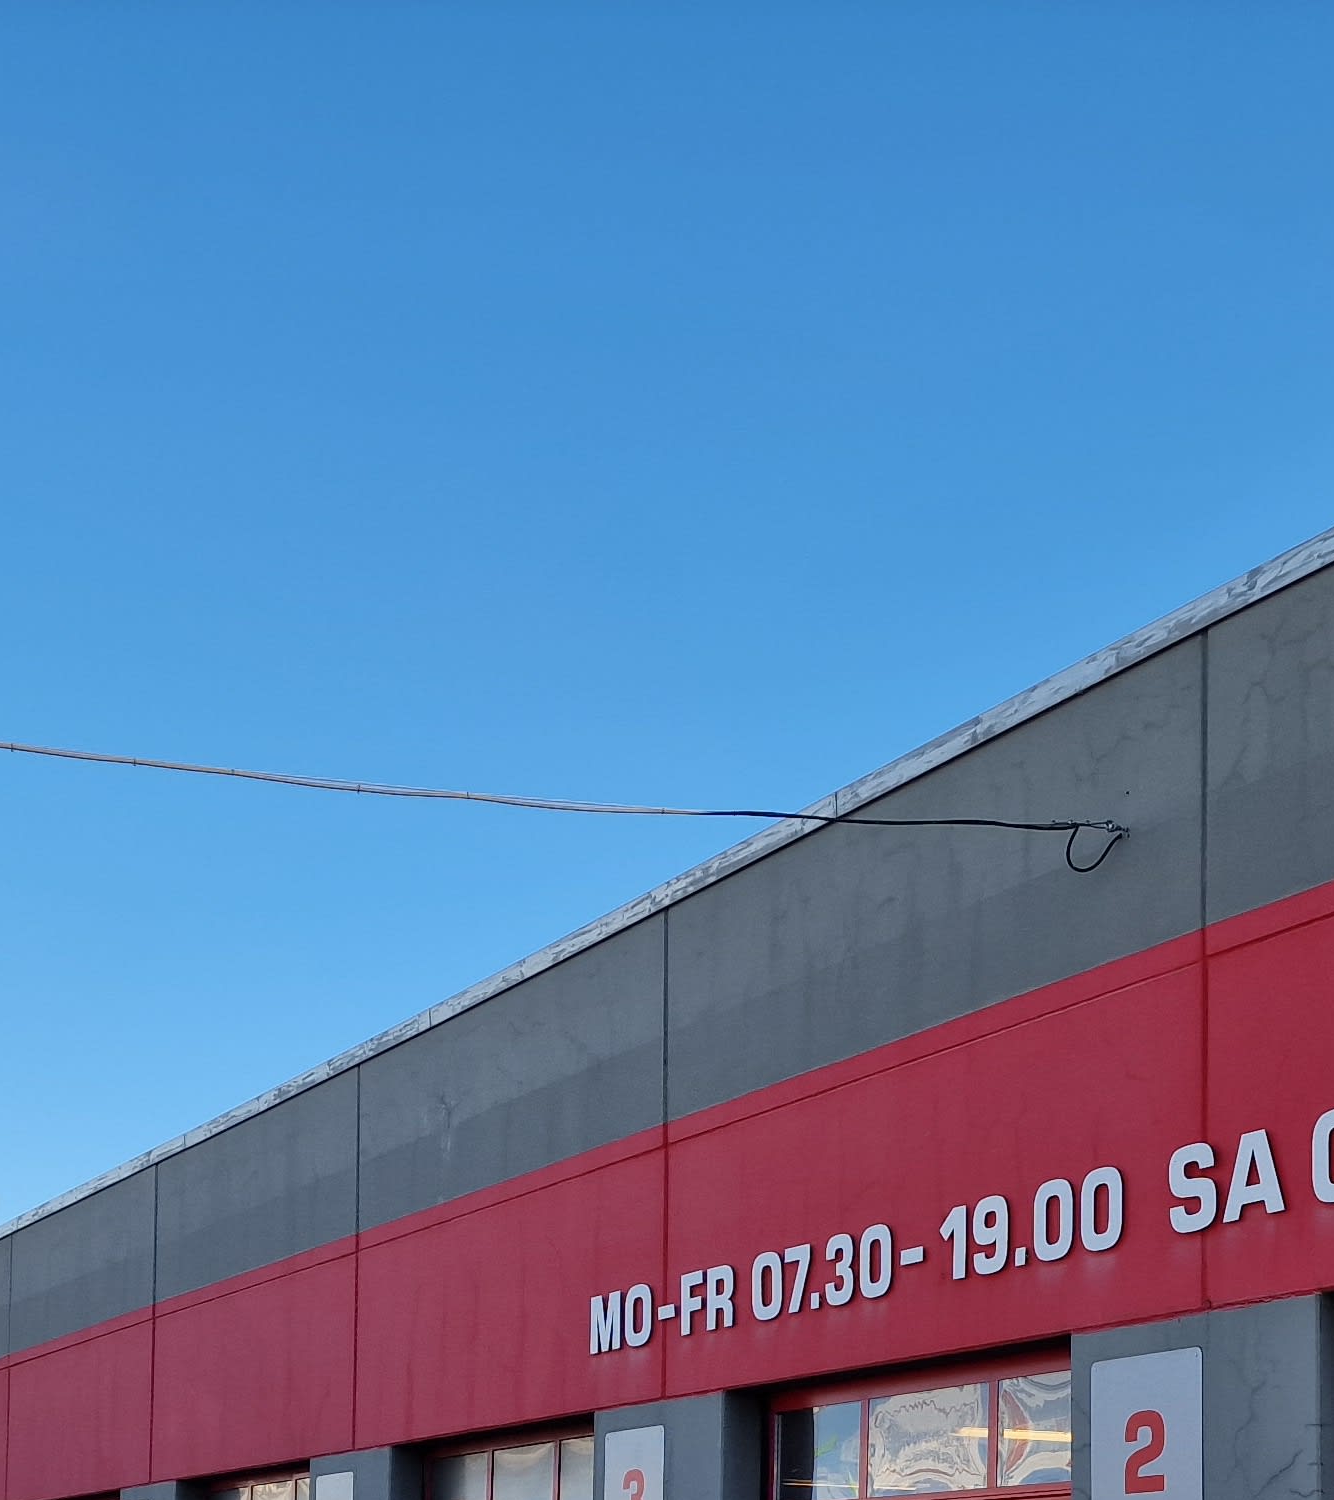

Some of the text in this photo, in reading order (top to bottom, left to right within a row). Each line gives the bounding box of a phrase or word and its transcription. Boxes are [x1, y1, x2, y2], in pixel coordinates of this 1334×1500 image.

[589, 1264, 735, 1355] MO-FR
[1168, 1128, 1285, 1234] SA
[1124, 1410, 1166, 1495] 2
